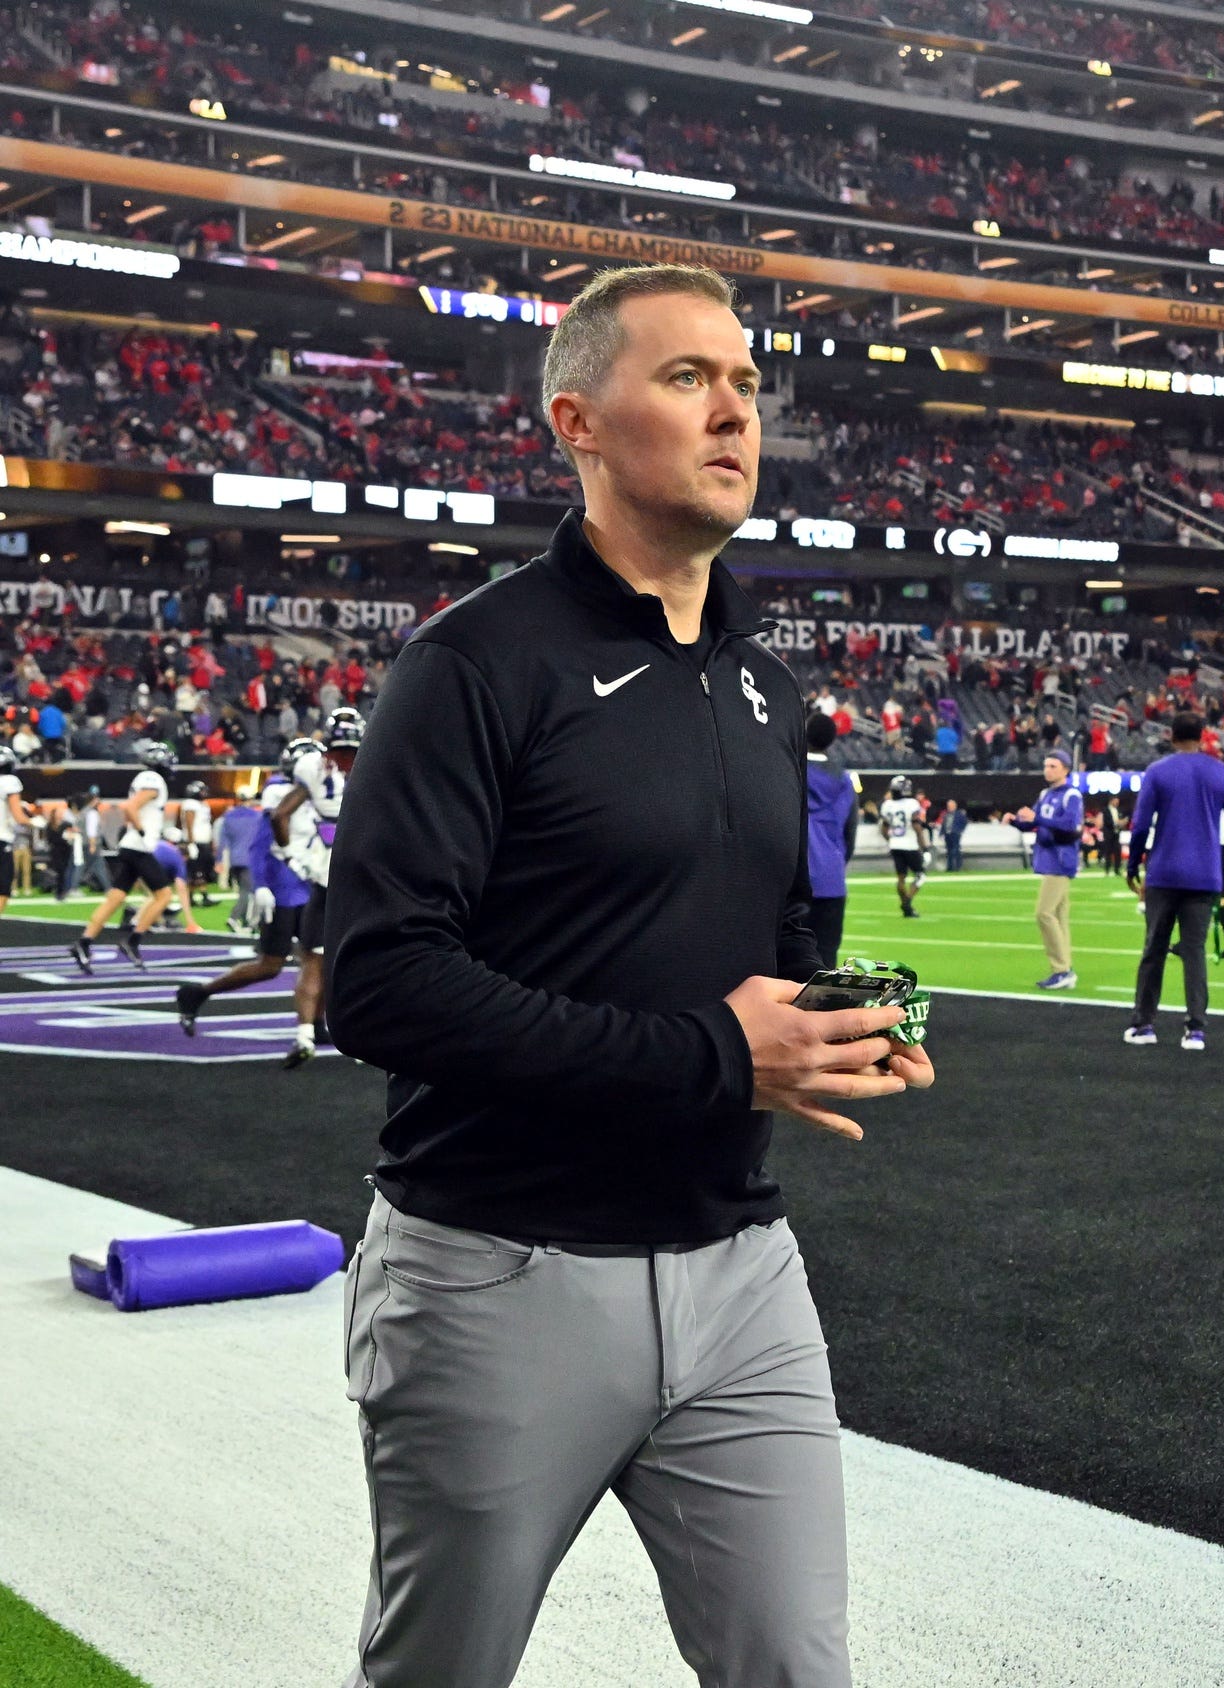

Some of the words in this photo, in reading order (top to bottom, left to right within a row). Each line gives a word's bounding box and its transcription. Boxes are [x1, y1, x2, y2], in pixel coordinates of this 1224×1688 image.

[456, 213, 585, 250] NATIONAL
[587, 231, 765, 272] CHAMPIONSHIP
[838, 976, 881, 987] 223
